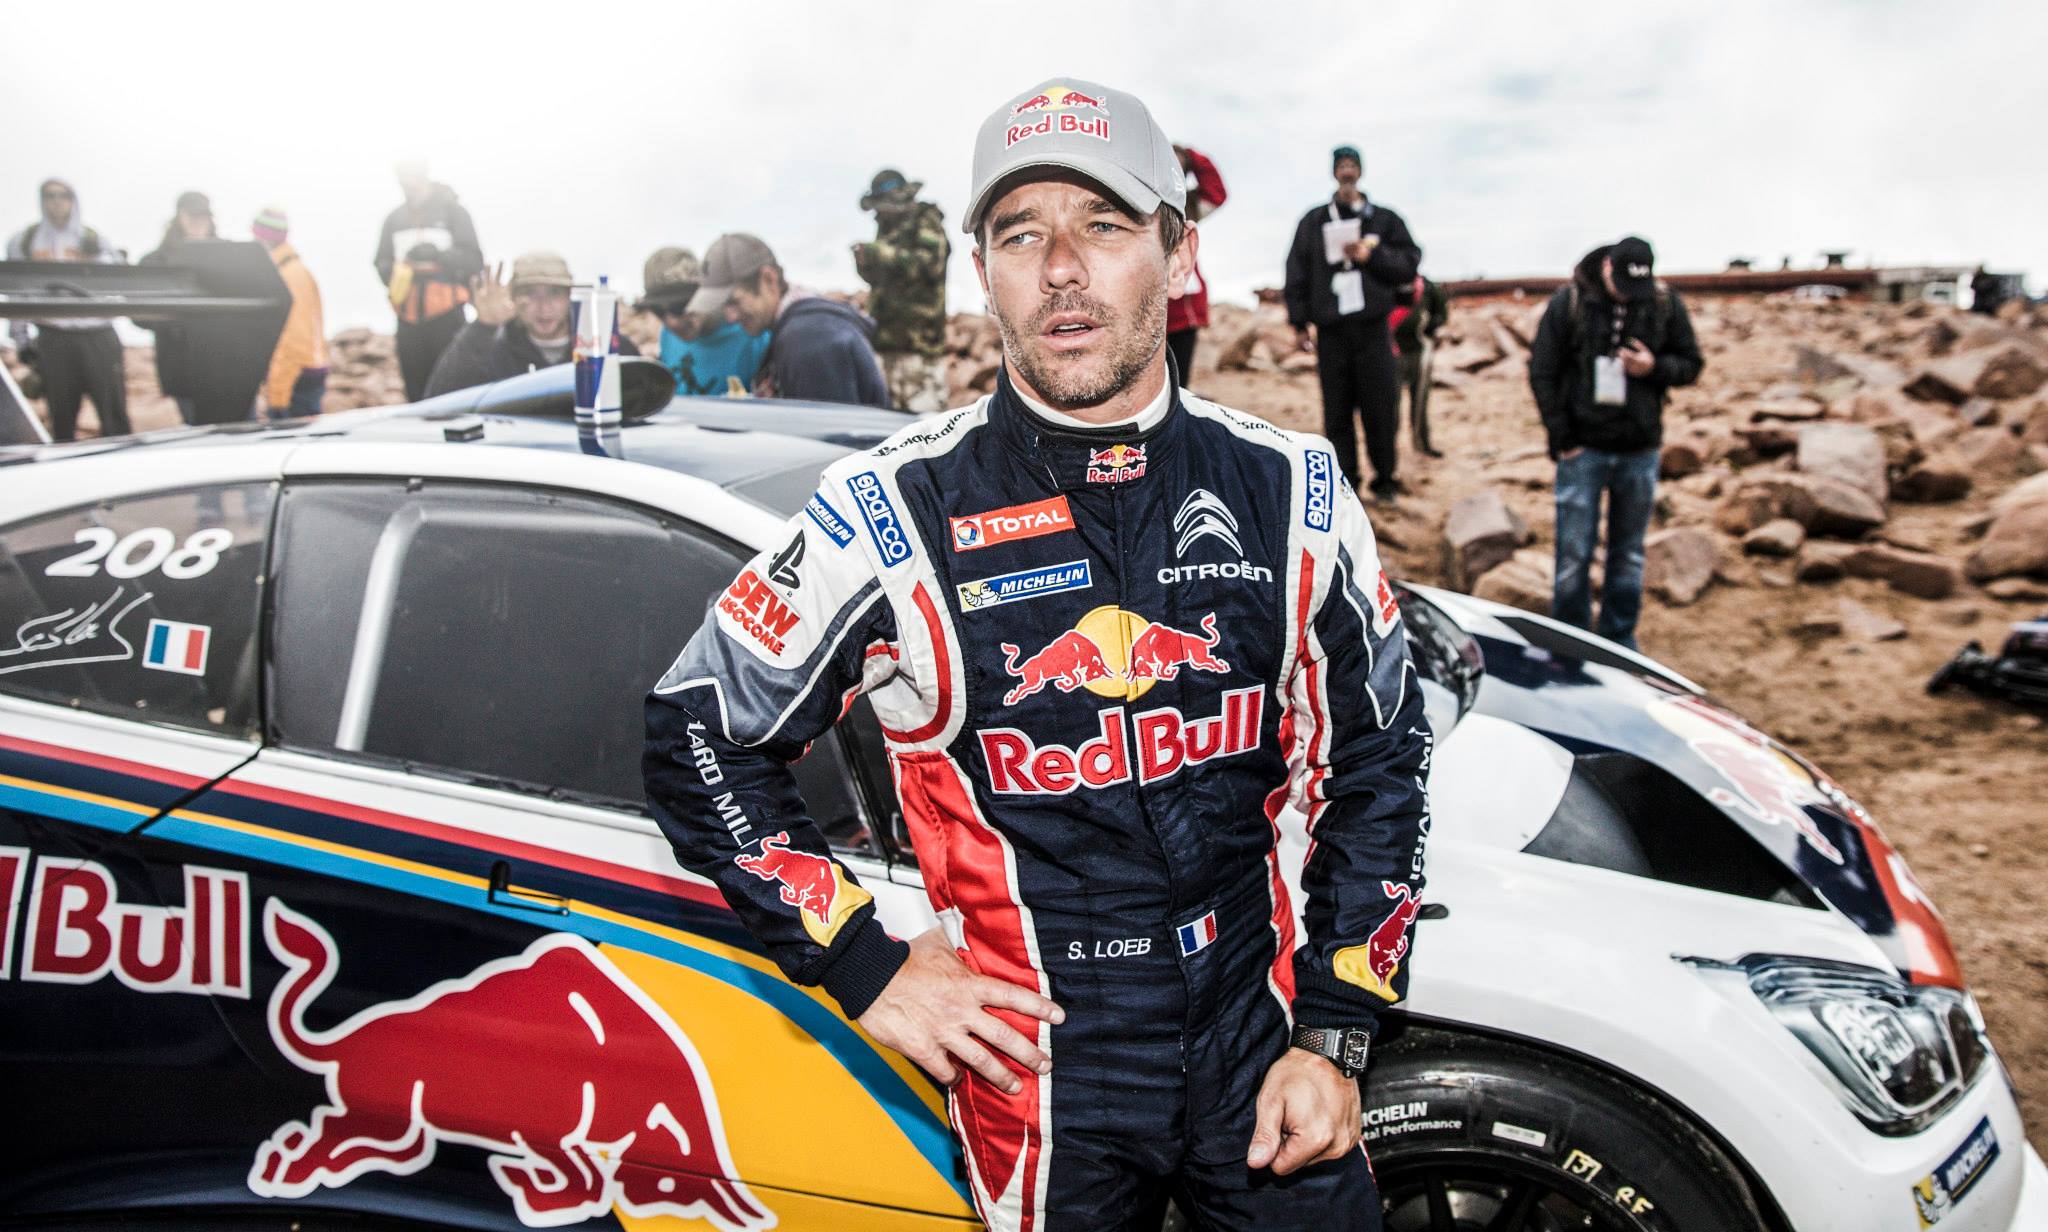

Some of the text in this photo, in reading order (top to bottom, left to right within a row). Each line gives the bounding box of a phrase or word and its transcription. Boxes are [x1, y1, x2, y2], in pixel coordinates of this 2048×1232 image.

[1005, 113, 1110, 149] Red Bull
[1087, 463, 1147, 482] Red Bull
[1307, 451, 1331, 527] sparco
[855, 475, 907, 559] sparco
[986, 510, 1067, 534] TOTAL
[44, 527, 234, 580] 208
[1000, 568, 1085, 594] MICHELIN
[729, 570, 800, 638] SEW
[976, 684, 1265, 795] Red Bull
[21, 856, 251, 1000] Bull
[1067, 938, 1151, 959] S. LOEB
[1361, 1101, 1428, 1127] ICHELIN
[1382, 1120, 1462, 1136] Performance
